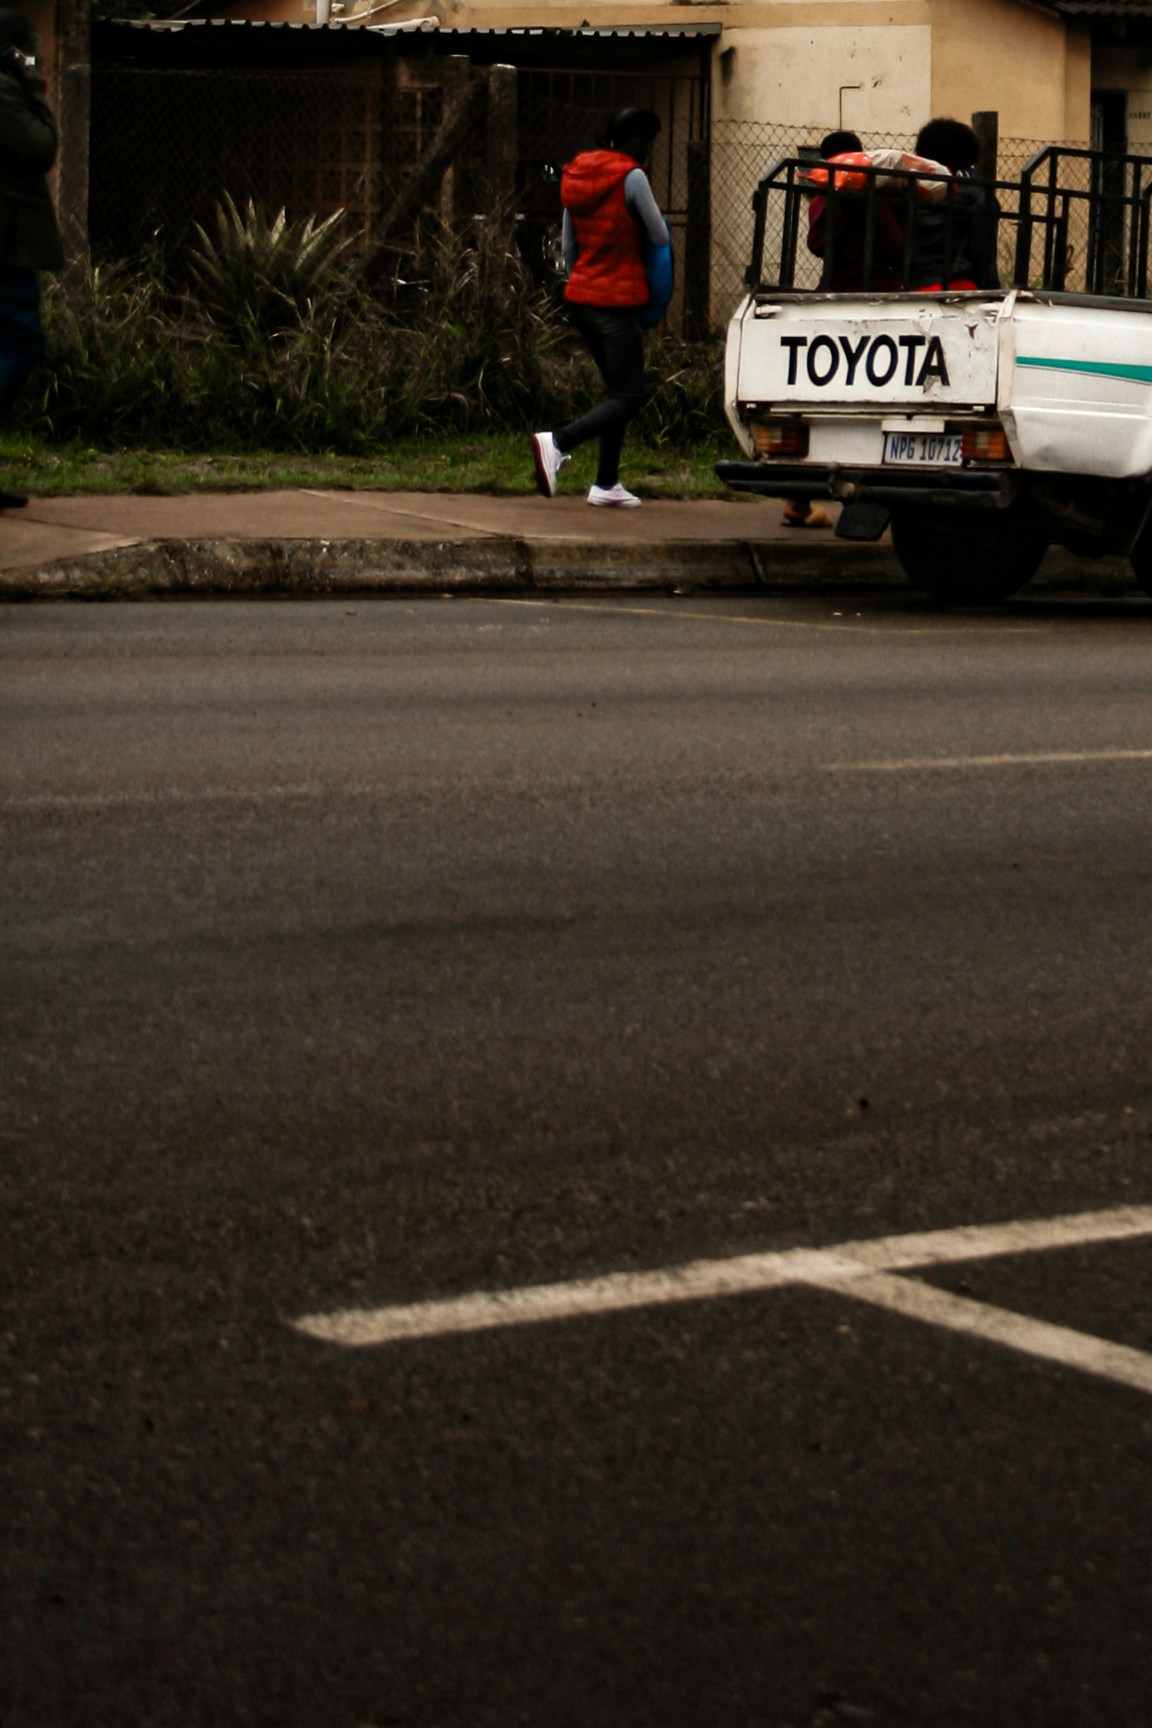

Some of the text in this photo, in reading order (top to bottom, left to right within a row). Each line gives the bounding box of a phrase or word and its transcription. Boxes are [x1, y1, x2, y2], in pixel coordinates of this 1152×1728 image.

[780, 334, 950, 387] TOYOTA
[890, 436, 960, 462] NPG 10712
